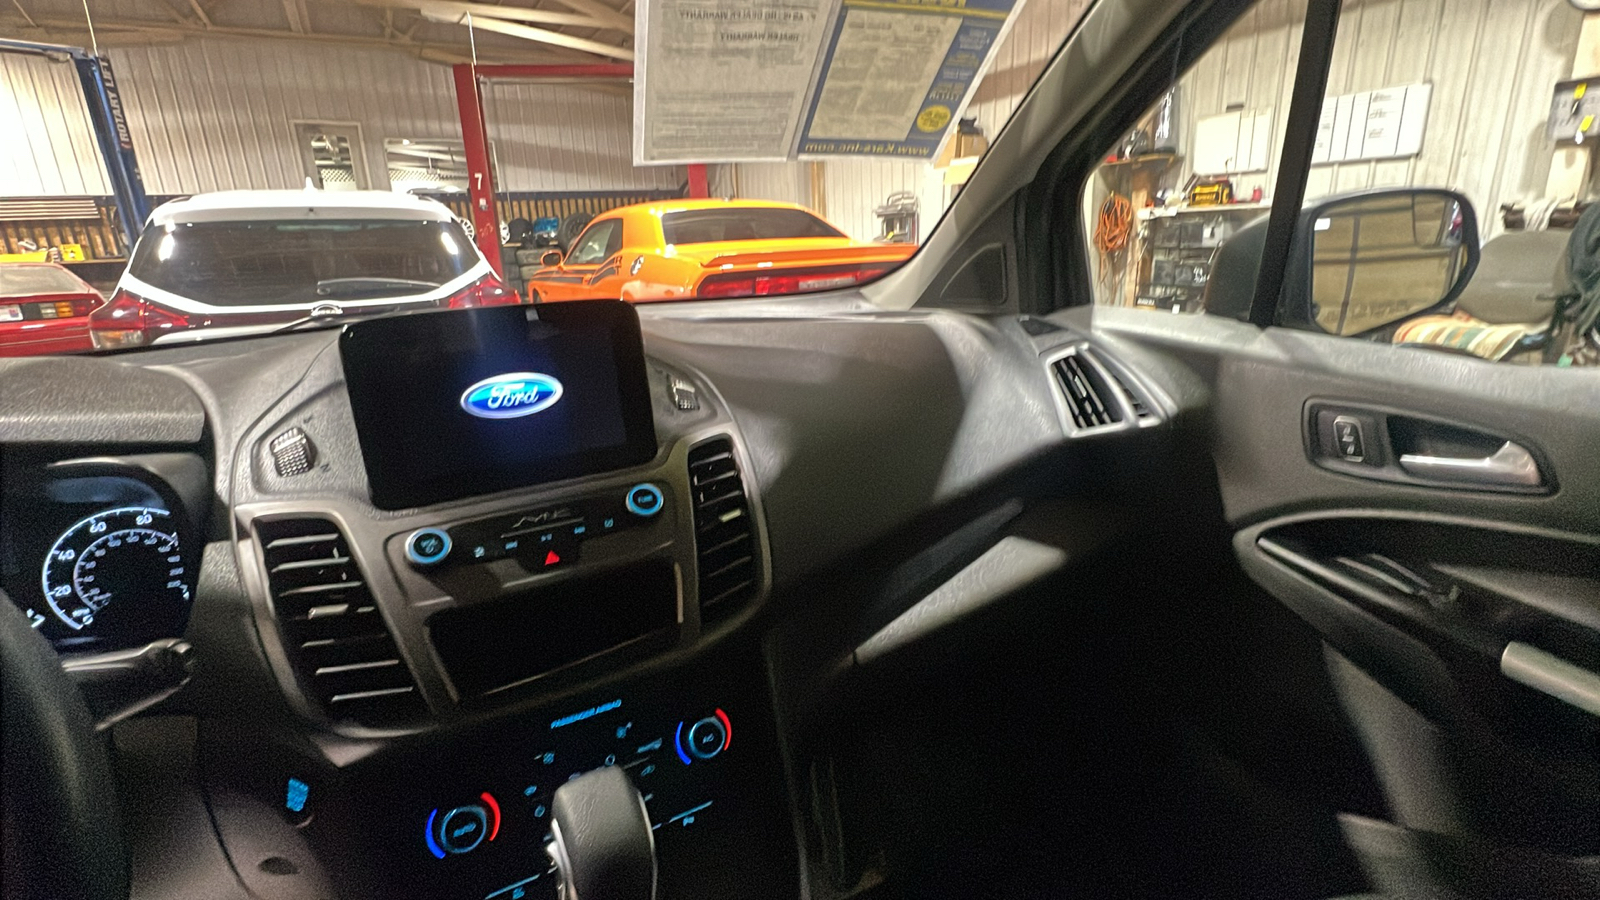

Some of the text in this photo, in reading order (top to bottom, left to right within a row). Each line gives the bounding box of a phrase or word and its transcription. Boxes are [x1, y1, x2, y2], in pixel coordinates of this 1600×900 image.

[101, 61, 130, 142] ROTARY LIFT
[474, 172, 483, 191] 7
[487, 382, 539, 408] Ford
[136, 513, 153, 525] 80
[90, 521, 107, 533] 60
[58, 549, 75, 561] 40
[55, 584, 72, 597] 20
